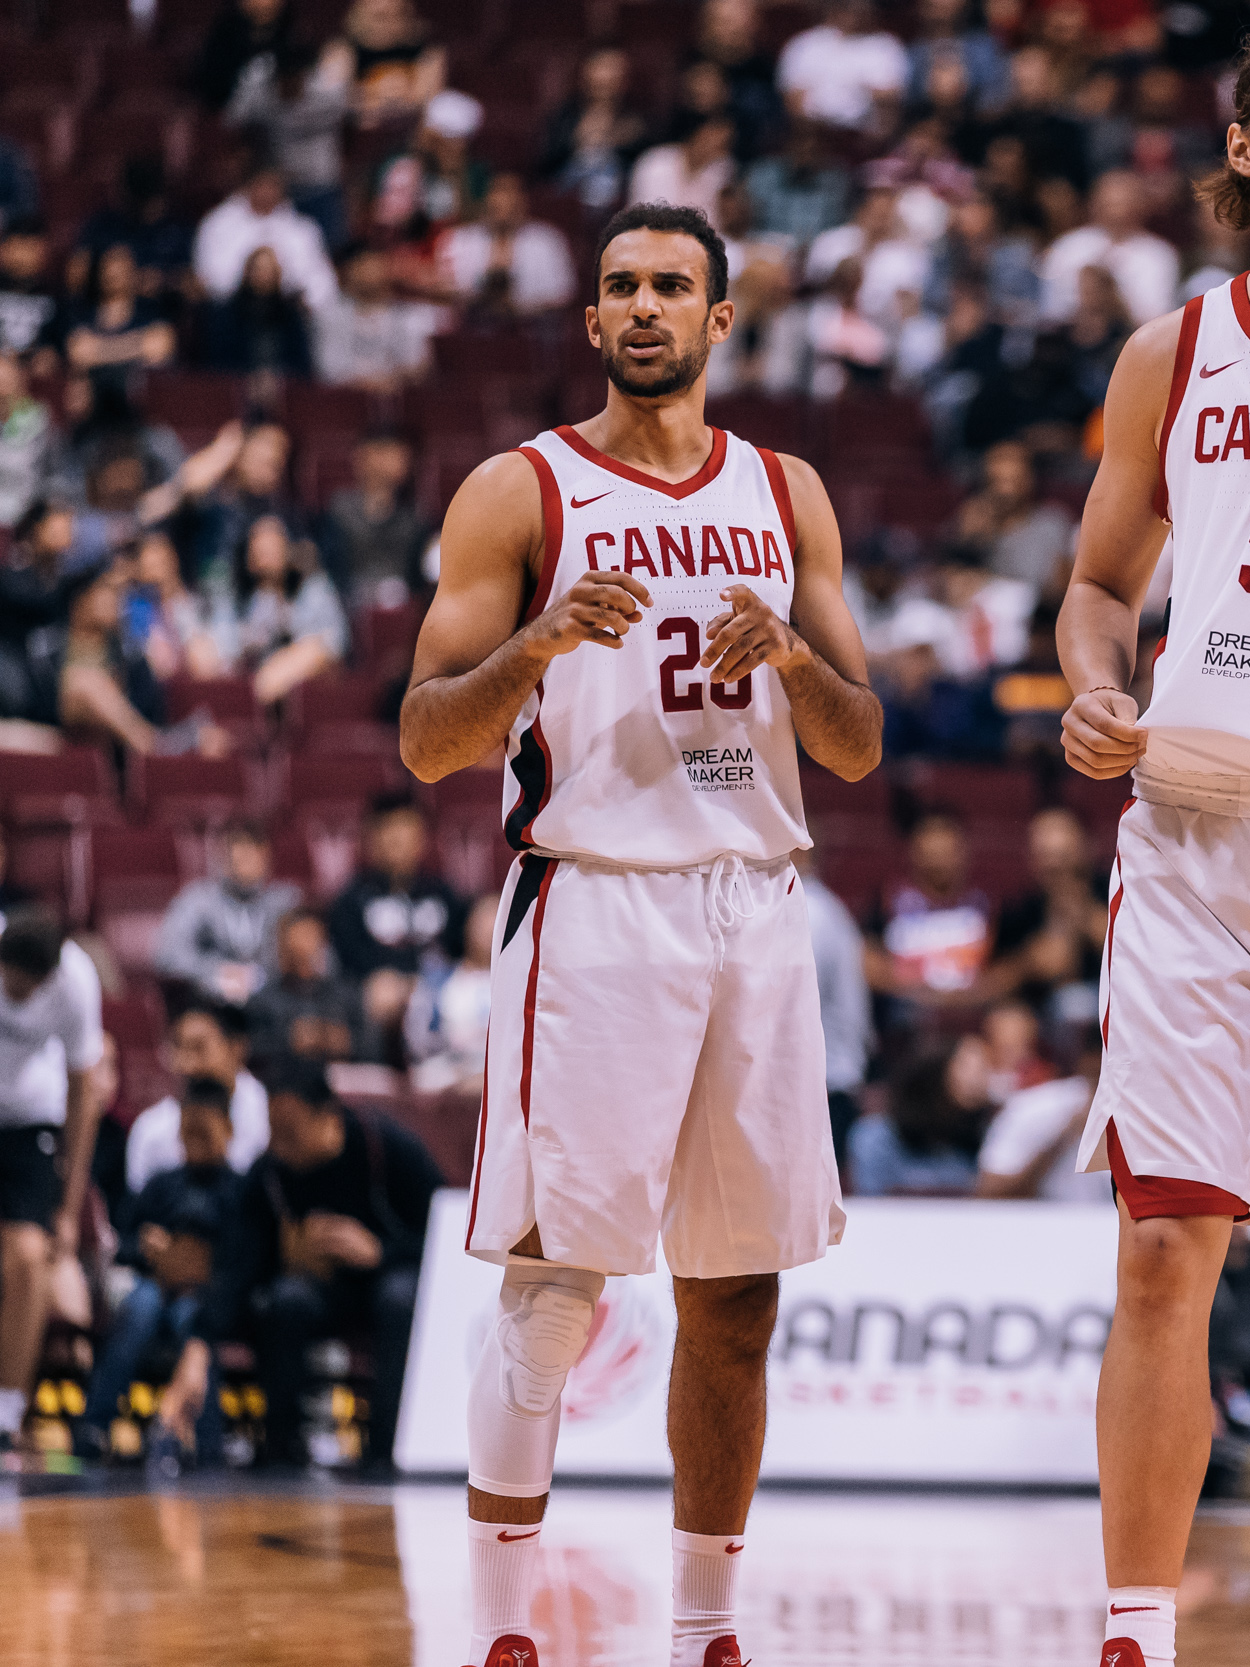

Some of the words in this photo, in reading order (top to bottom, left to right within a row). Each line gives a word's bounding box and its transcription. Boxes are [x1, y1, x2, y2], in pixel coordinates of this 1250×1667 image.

[585, 525, 788, 584] CANADA
[682, 747, 753, 765] DREAM
[687, 766, 754, 783] MAKER
[692, 783, 755, 792] DEVELOPMENTS
[777, 1302, 1112, 1370] ANADA
